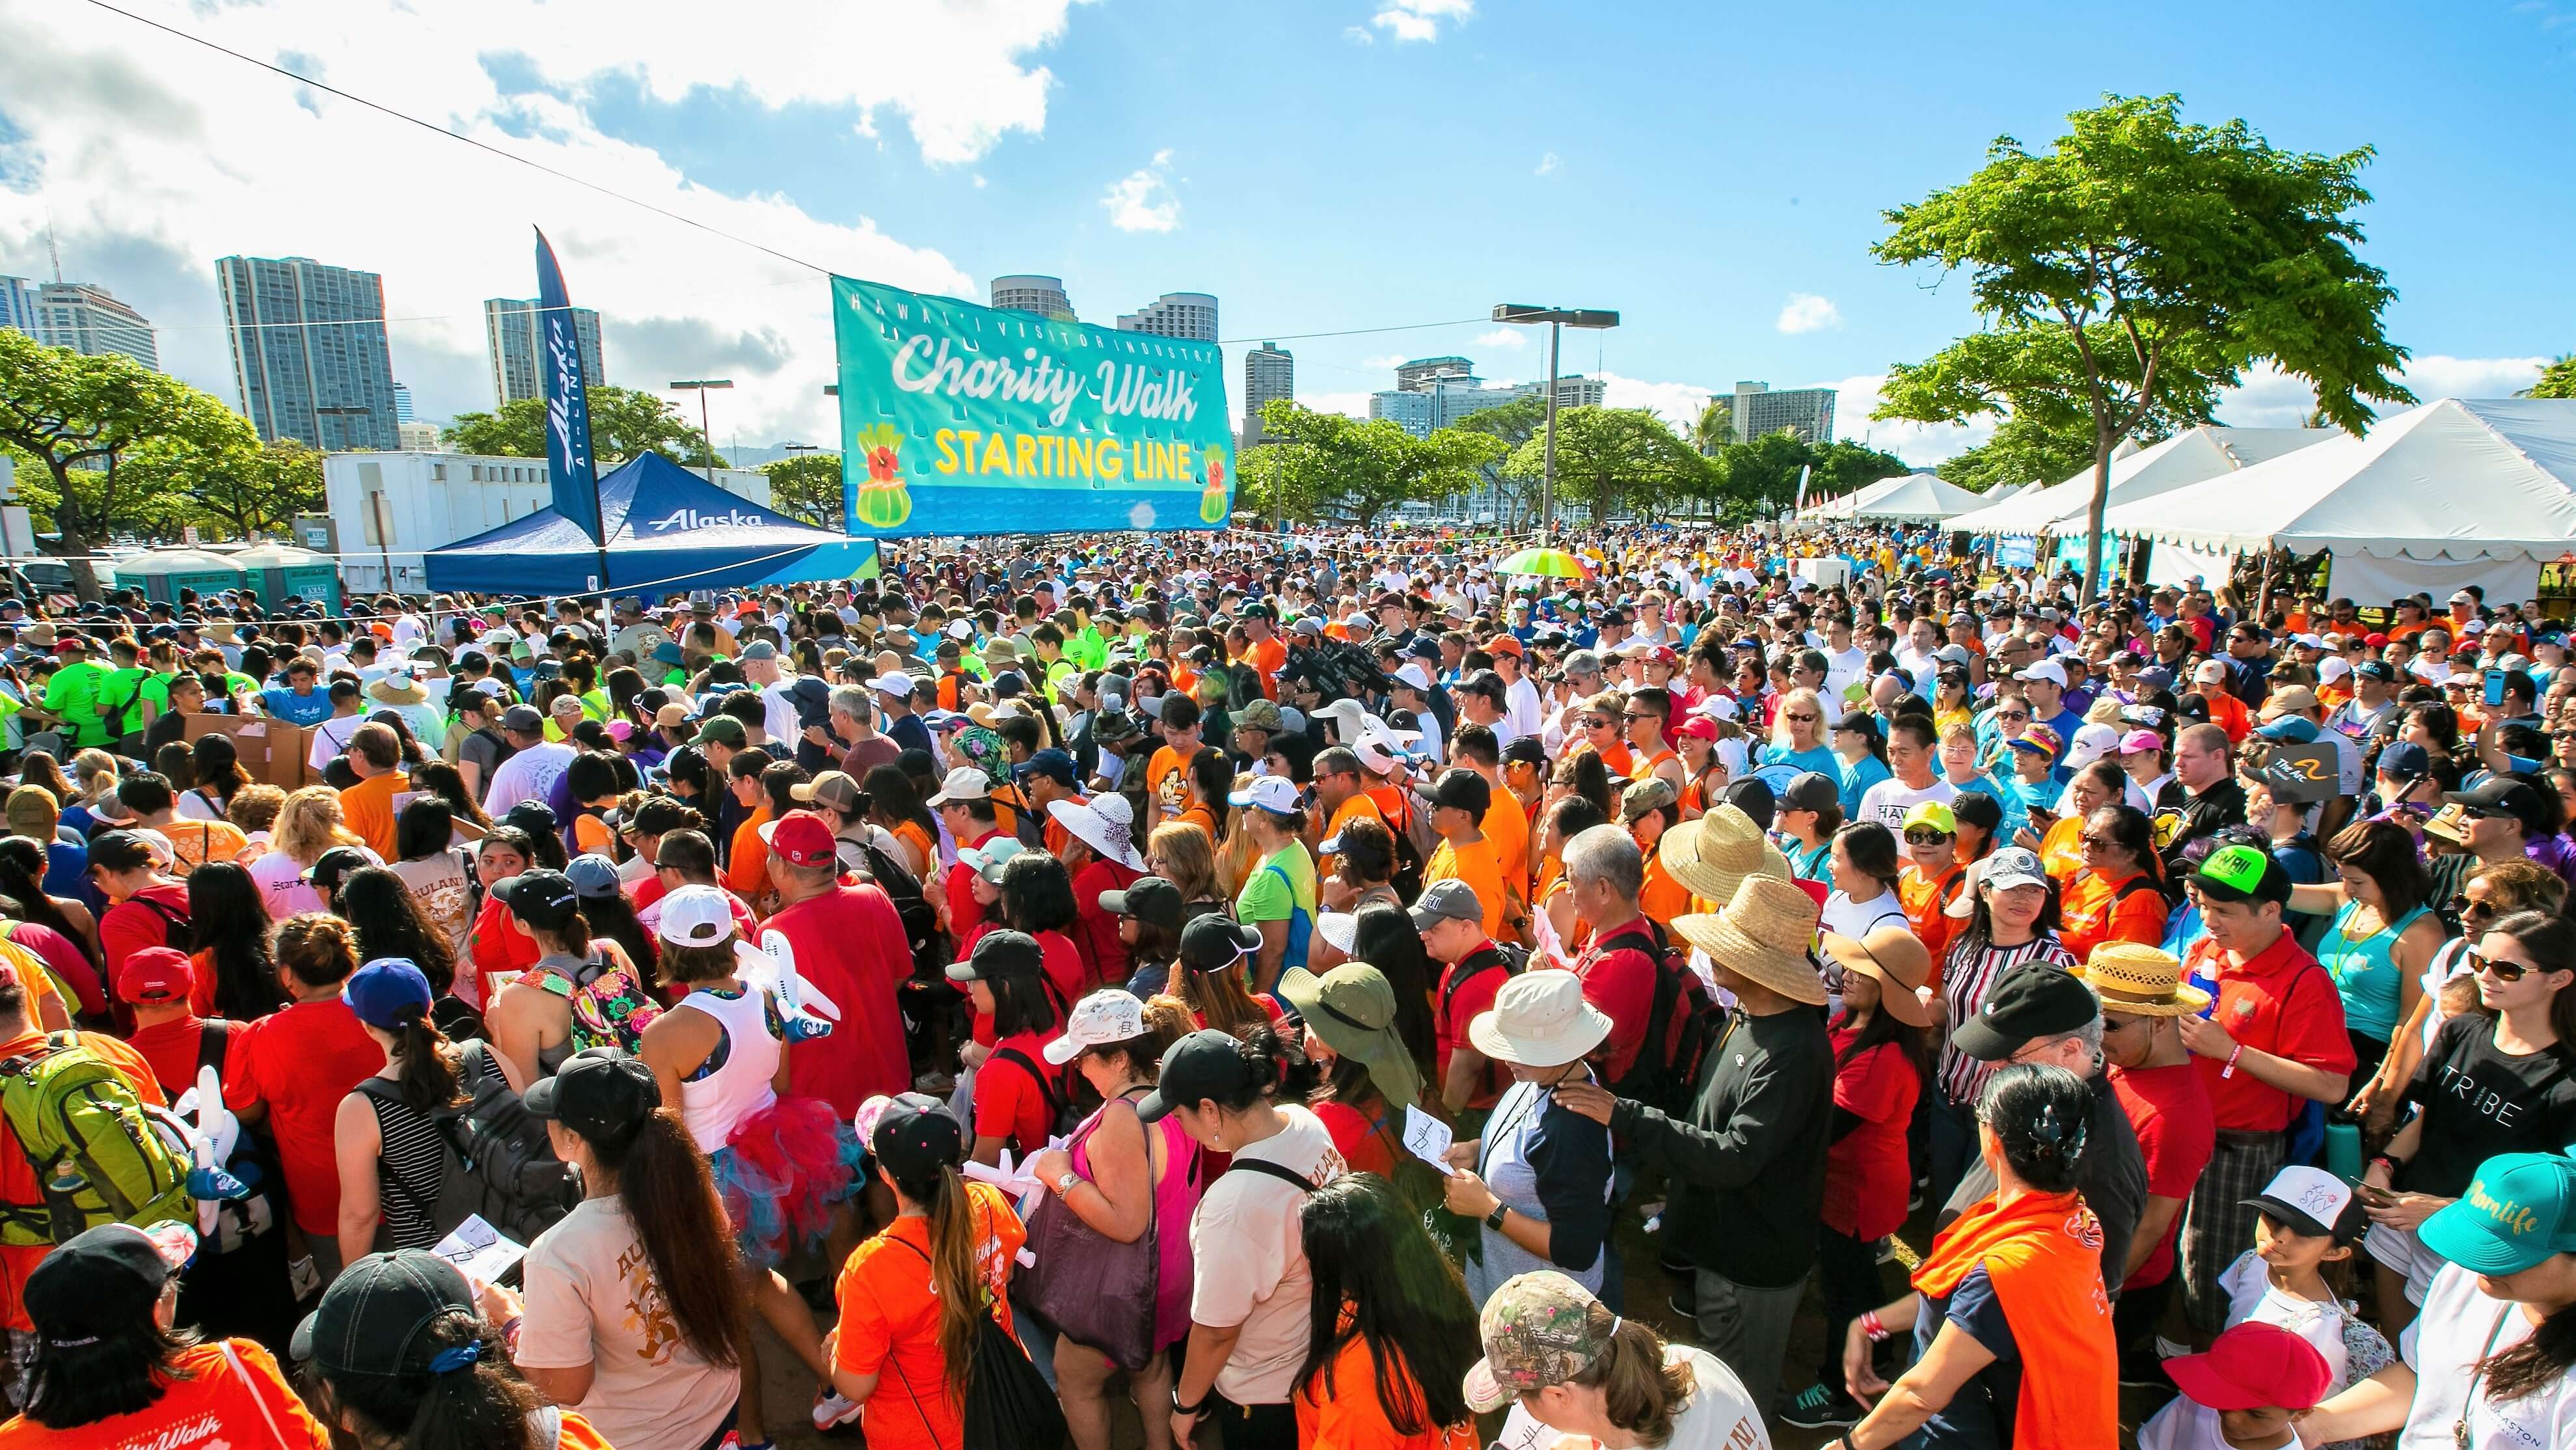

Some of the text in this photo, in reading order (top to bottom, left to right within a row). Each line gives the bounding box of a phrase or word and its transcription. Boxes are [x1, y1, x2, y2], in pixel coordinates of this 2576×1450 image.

[997, 321, 1104, 349] VISITOR
[1113, 339, 1212, 364] INDUSTRY
[892, 334, 1198, 427] Charity Walk
[935, 428, 1191, 480] STARTING LINE
[647, 508, 763, 532] Alaska
[1291, 652, 1303, 664] 63
[2275, 758, 2294, 773] The
[2289, 770, 2308, 784] Arc
[273, 881, 294, 892] Star
[2440, 1065, 2523, 1128] TRIBE
[2299, 1190, 2333, 1214] SKY
[158, 1415, 223, 1450] Walk
